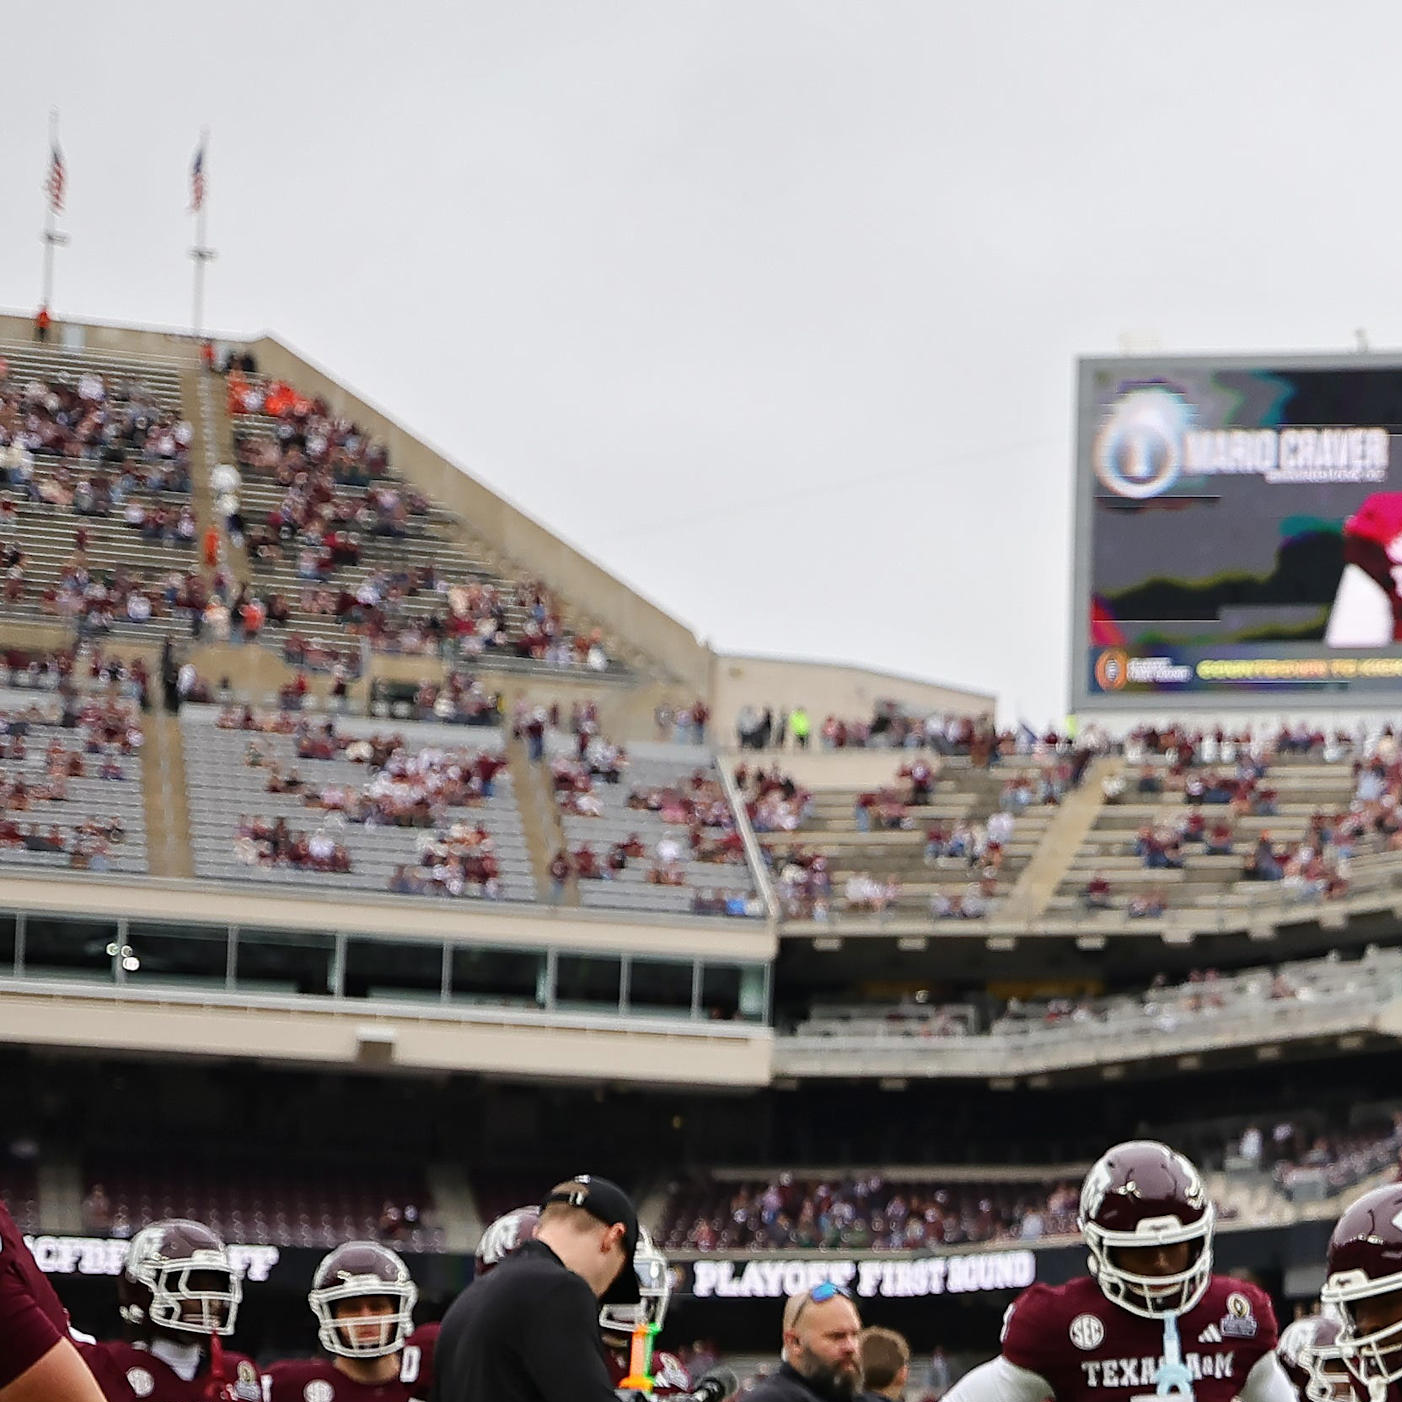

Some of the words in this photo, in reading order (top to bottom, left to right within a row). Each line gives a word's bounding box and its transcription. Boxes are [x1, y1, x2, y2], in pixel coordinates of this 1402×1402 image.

[857, 1258, 946, 1297] FIRST
[946, 1250, 1036, 1295] ROUND
[1073, 1317, 1102, 1347] SEC
[1081, 1355, 1165, 1388] TEXA
